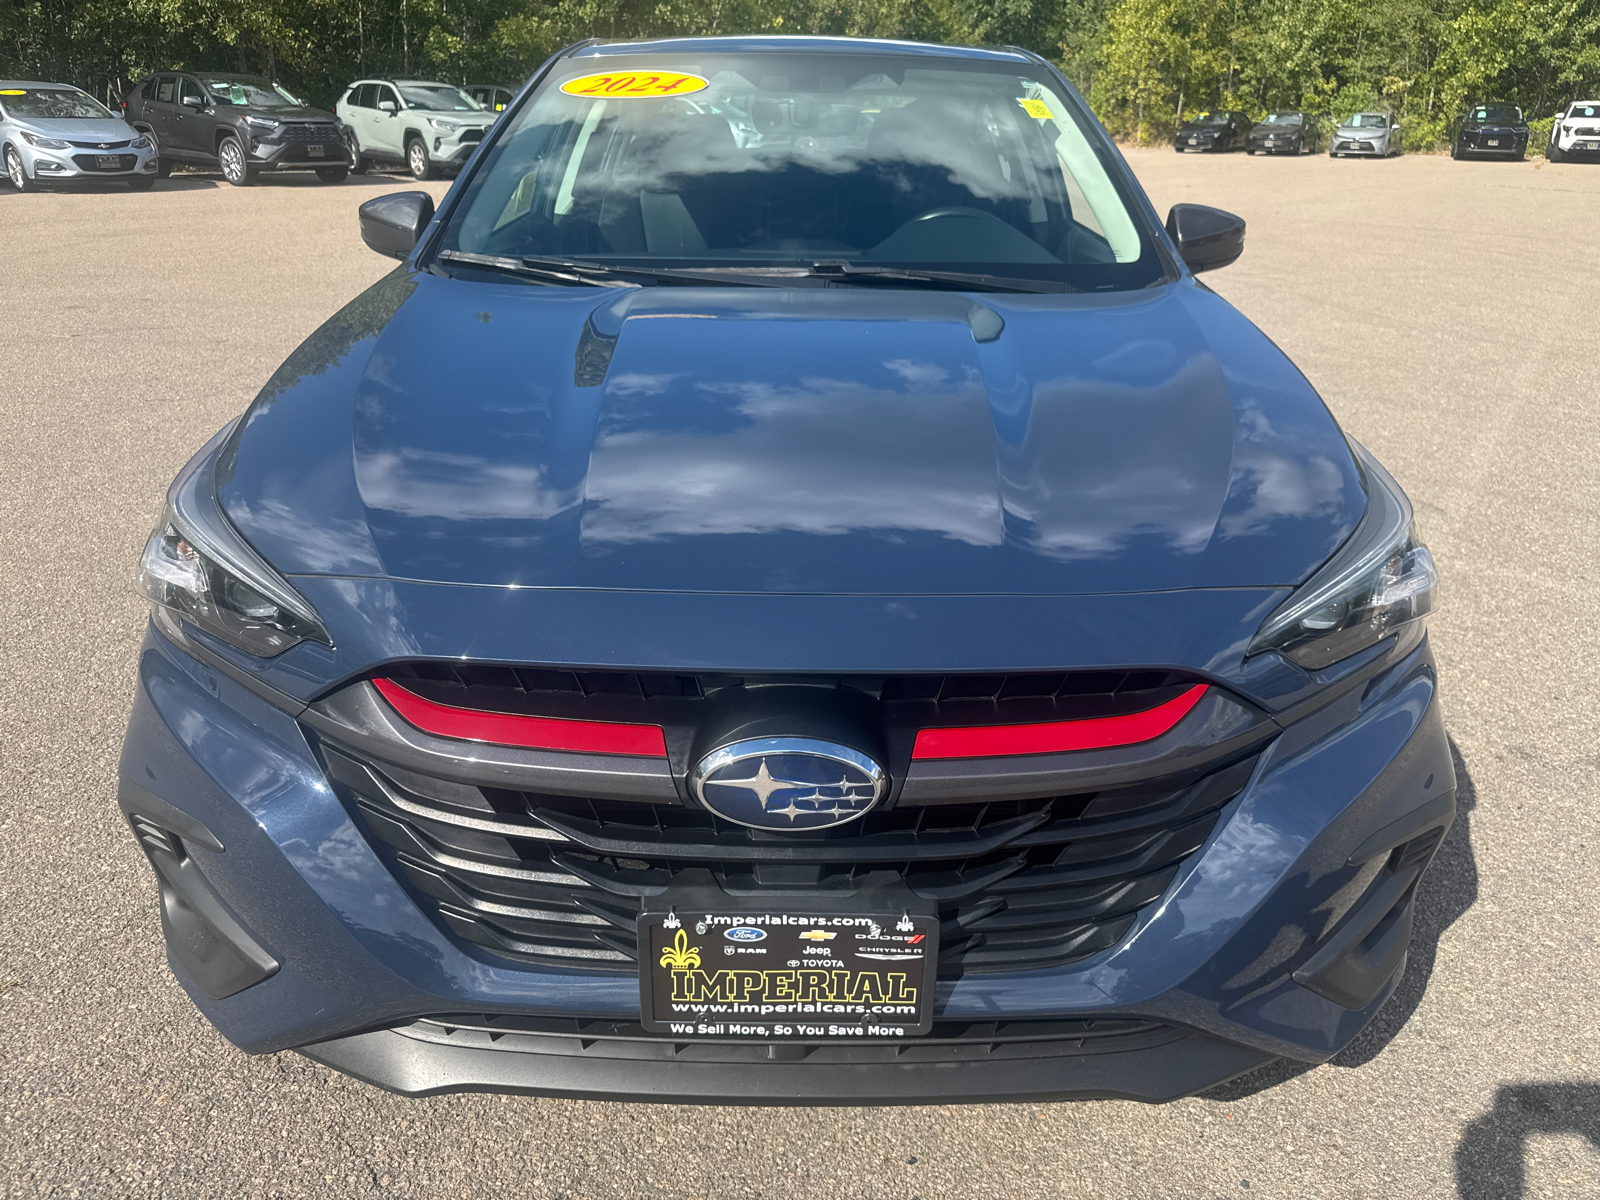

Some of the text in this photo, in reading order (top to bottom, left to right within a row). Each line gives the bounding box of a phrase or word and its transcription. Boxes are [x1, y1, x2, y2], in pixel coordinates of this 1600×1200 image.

[577, 76, 690, 94] 2024
[704, 914, 873, 926] Imperialcars.com
[733, 929, 758, 940] Ford
[854, 933, 915, 941] DODGE
[802, 945, 832, 956] Jeep
[858, 946, 923, 954] CHRYSLER
[801, 959, 845, 968] TOYOTA
[671, 969, 917, 1004] IMPERIAL
[671, 1002, 916, 1015] www.imperialcars.com
[670, 1023, 905, 1037] We Sell More, So You Save More
